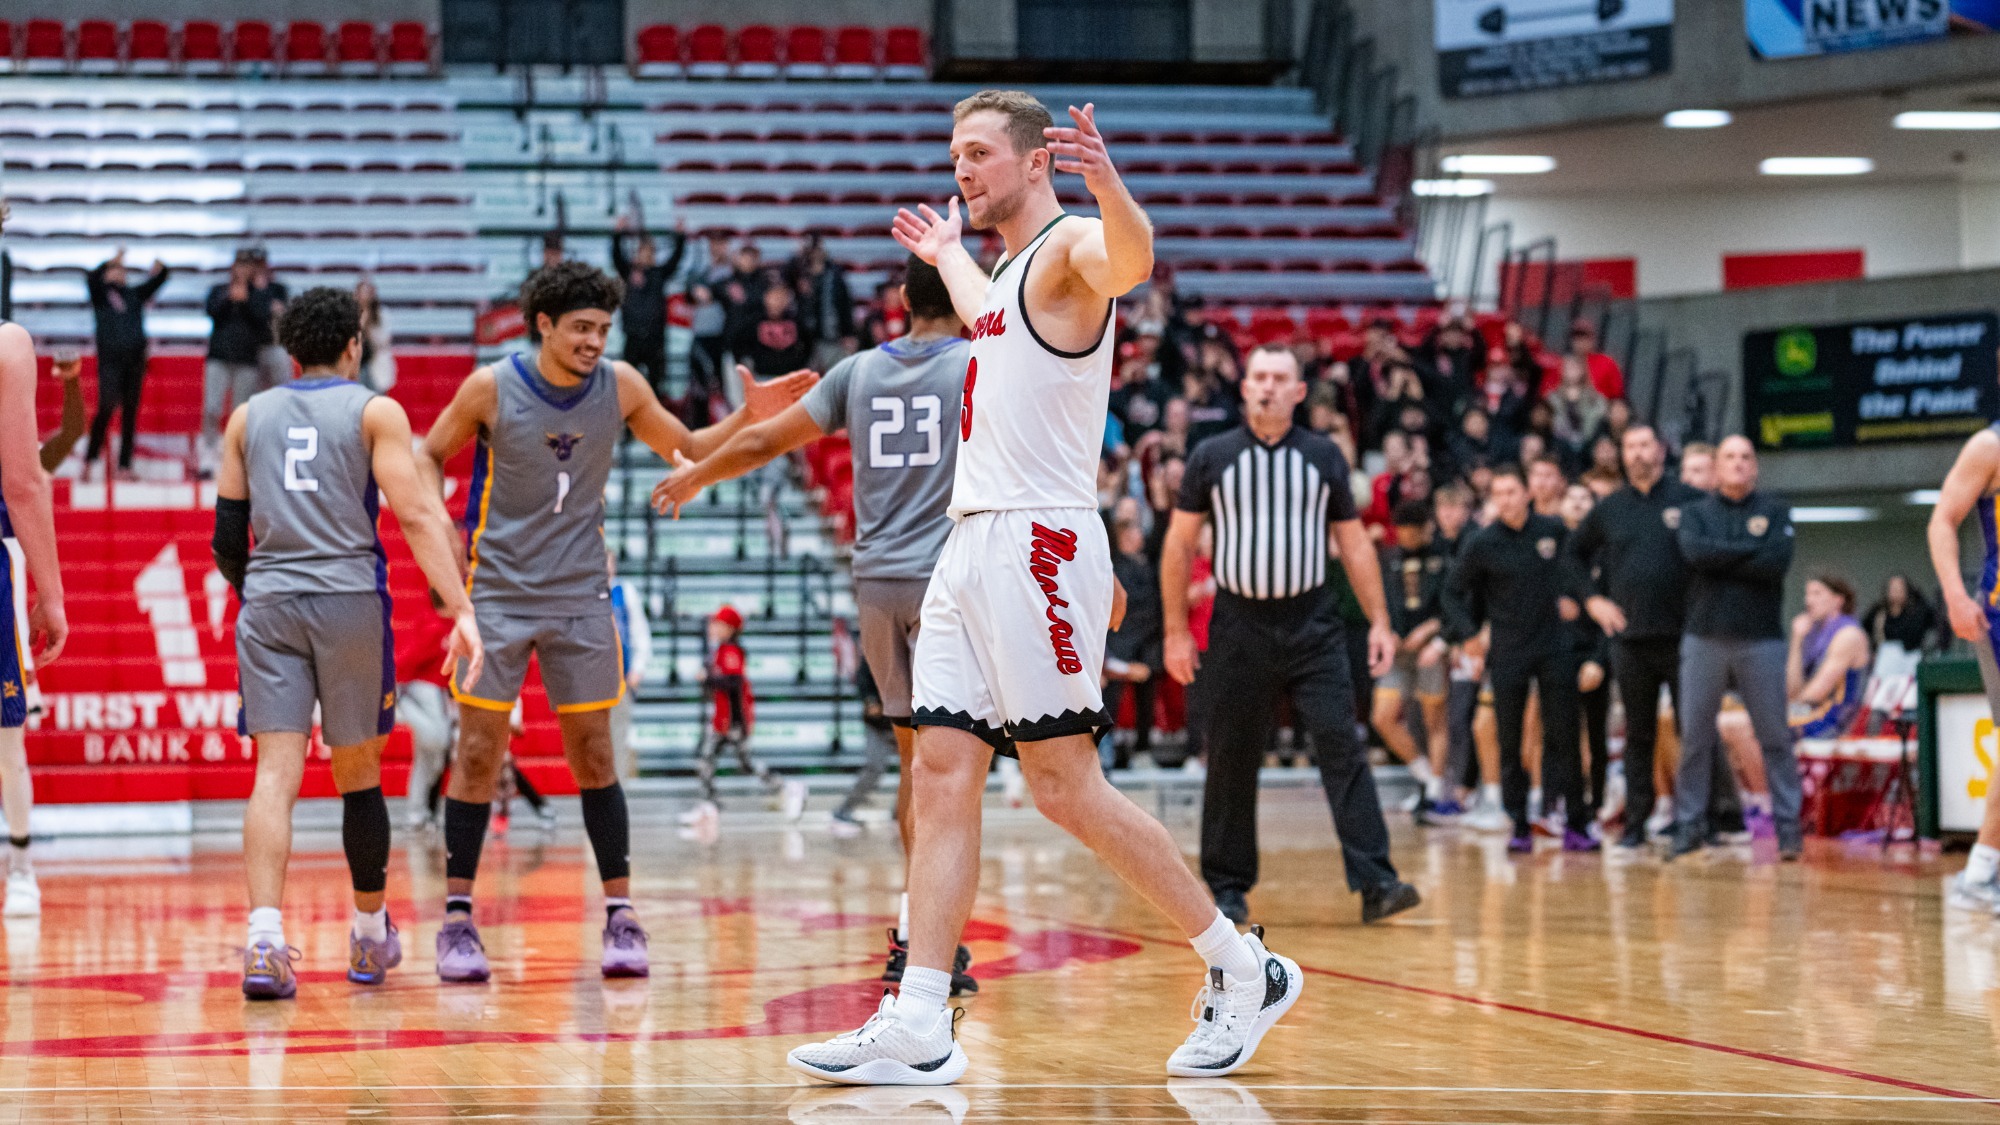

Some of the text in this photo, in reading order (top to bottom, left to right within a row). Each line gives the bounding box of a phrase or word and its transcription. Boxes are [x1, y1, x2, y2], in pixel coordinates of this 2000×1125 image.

[1812, 0, 1942, 34] NEWS
[1851, 321, 1987, 355] The Power
[1874, 352, 1963, 387] Behind
[1858, 391, 1906, 420] the
[869, 394, 942, 469] 23
[284, 426, 319, 492] 2
[553, 471, 570, 514] 1
[84, 733, 191, 763] BANK
[201, 733, 226, 761] &
